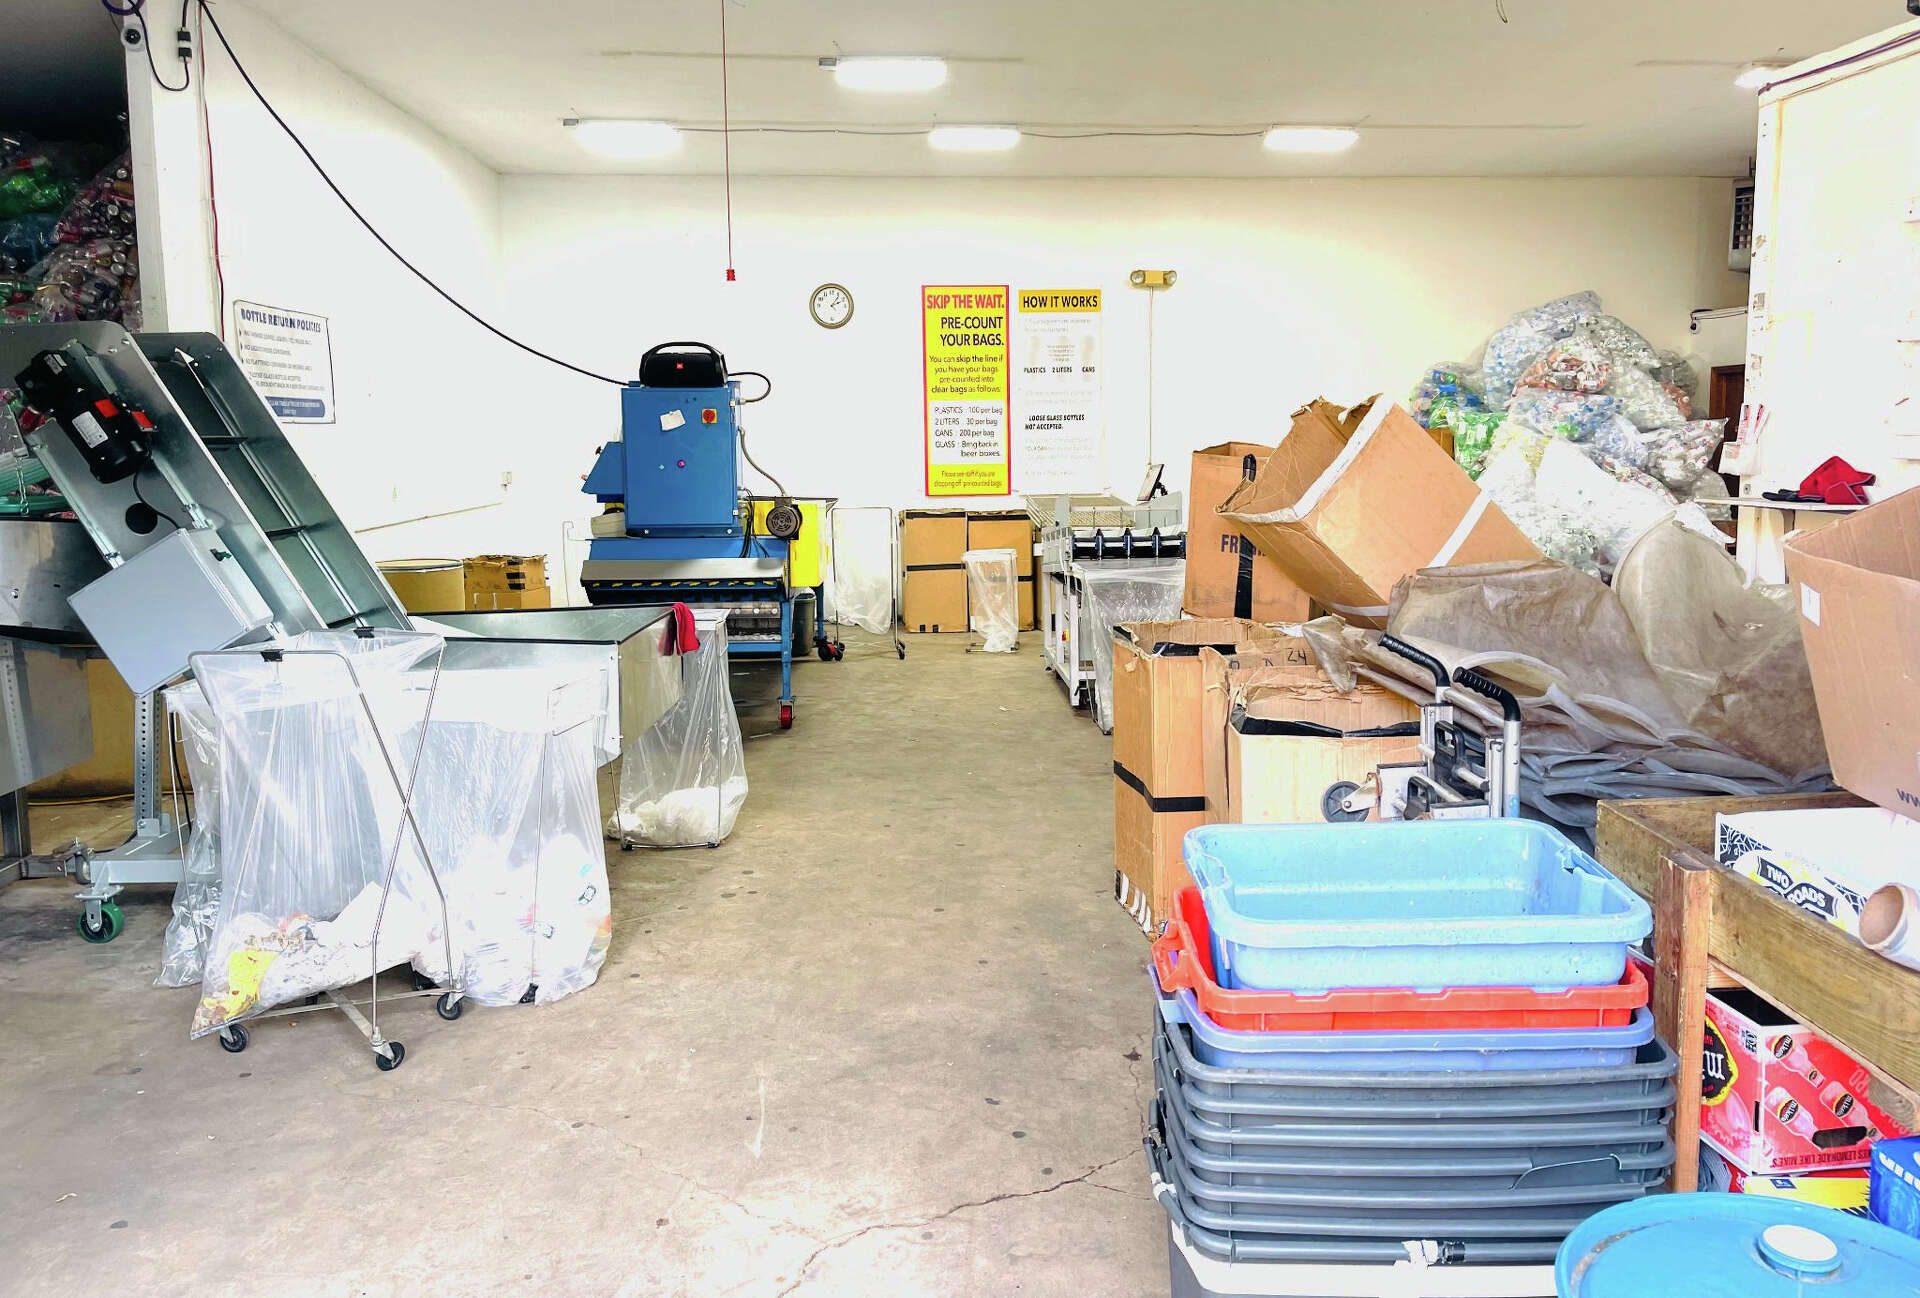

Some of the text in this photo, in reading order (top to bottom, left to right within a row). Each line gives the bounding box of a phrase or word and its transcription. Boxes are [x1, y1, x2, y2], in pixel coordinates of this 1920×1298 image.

[927, 294, 1005, 309] SKIP THE WAIT.
[1023, 295, 1098, 308] HOW IT WORKS
[240, 308, 321, 333] BOTTLE RETURN POLICIES
[941, 316, 1003, 329] PRE-COUNT
[940, 333, 1004, 346] YOUR BAGS.
[929, 355, 942, 363] You
[956, 354, 971, 364] skip
[972, 354, 984, 363] the
[984, 354, 998, 362] line
[934, 367, 947, 375] you
[982, 365, 998, 374] bags
[950, 385, 968, 395] bags
[935, 406, 964, 414] PLASTICS
[940, 417, 960, 426] LITERS
[986, 417, 998, 427] bag
[935, 429, 995, 438] CANS 200 per bag
[935, 441, 956, 449] GLASS
[1766, 864, 1790, 889] TWO
[1787, 886, 1826, 908] ROADS
[1800, 1154, 1816, 1165] LIKE
[1817, 1150, 1857, 1163] LEMONADE
